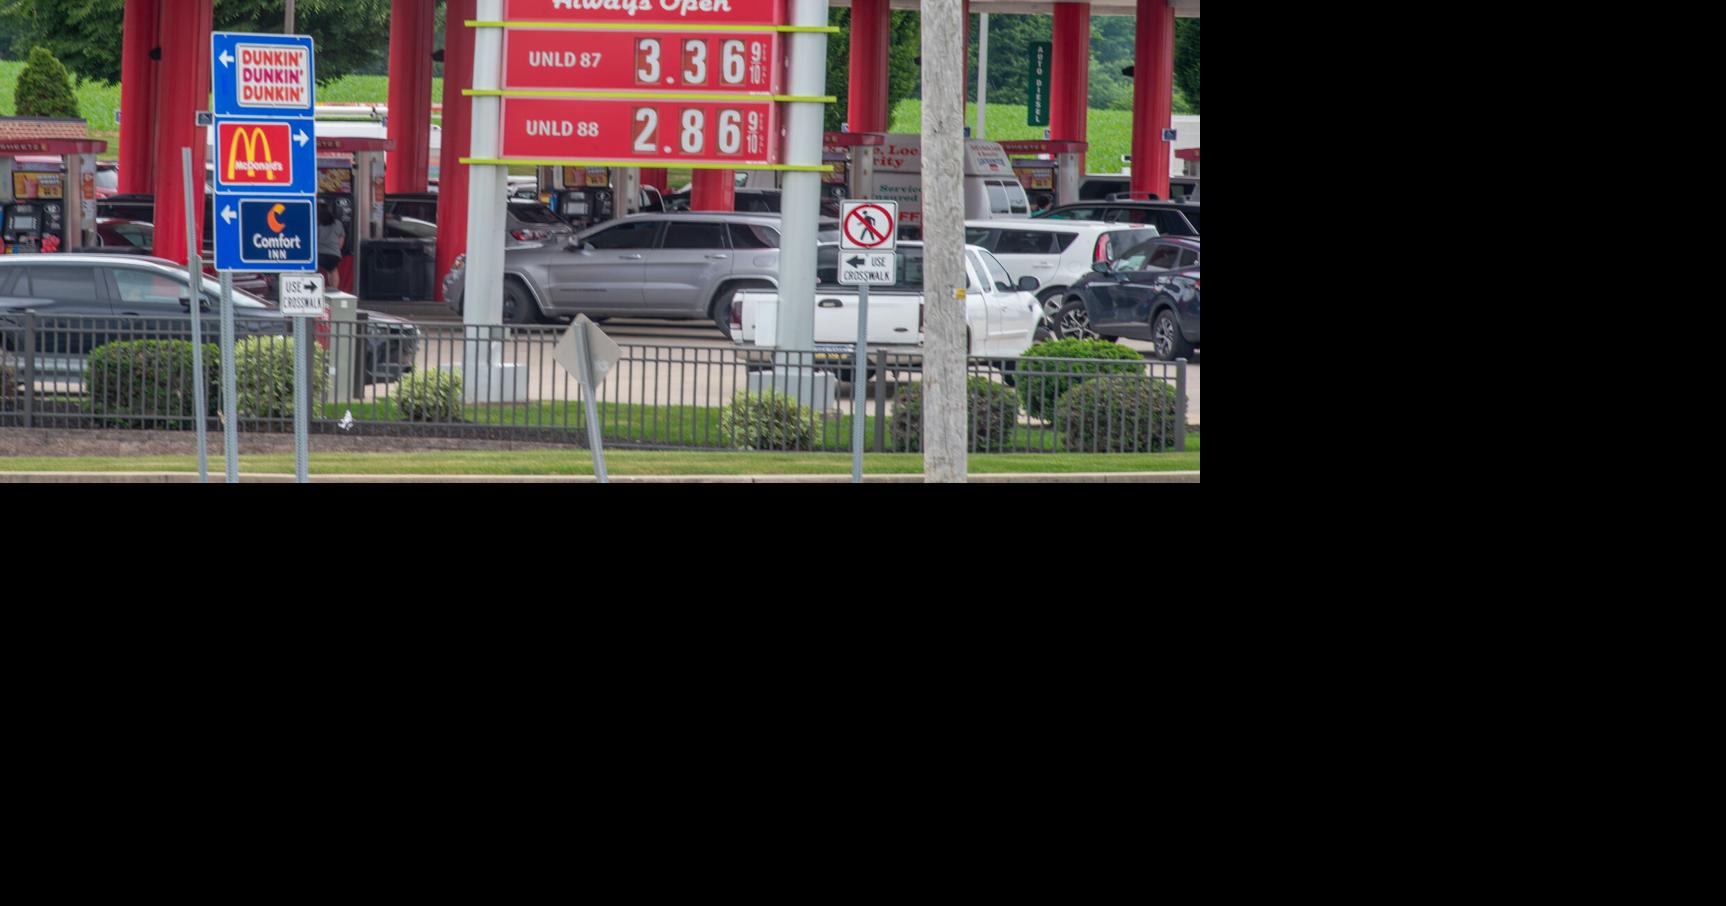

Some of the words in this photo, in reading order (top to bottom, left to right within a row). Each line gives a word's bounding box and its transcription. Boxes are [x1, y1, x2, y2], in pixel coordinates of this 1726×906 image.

[552, 0, 652, 17] Always
[660, 0, 732, 16] Open
[242, 50, 302, 67] DUNKIN'
[528, 50, 577, 68] UNLD
[580, 52, 602, 68] 87
[637, 38, 746, 85] 3.36
[242, 67, 303, 84] DUNKIN'
[243, 85, 304, 102] DUNKIN'
[526, 119, 573, 137] UNLD
[576, 121, 599, 137] 88
[633, 107, 742, 154] 2.86
[234, 160, 284, 172] McDonald's
[873, 157, 904, 168] rity
[252, 233, 301, 249] Comfort
[268, 250, 287, 260] INN
[871, 257, 886, 267] USE
[843, 271, 890, 281] CROSSWALK
[285, 281, 301, 294] USE
[283, 296, 322, 309] CROSSWALK
